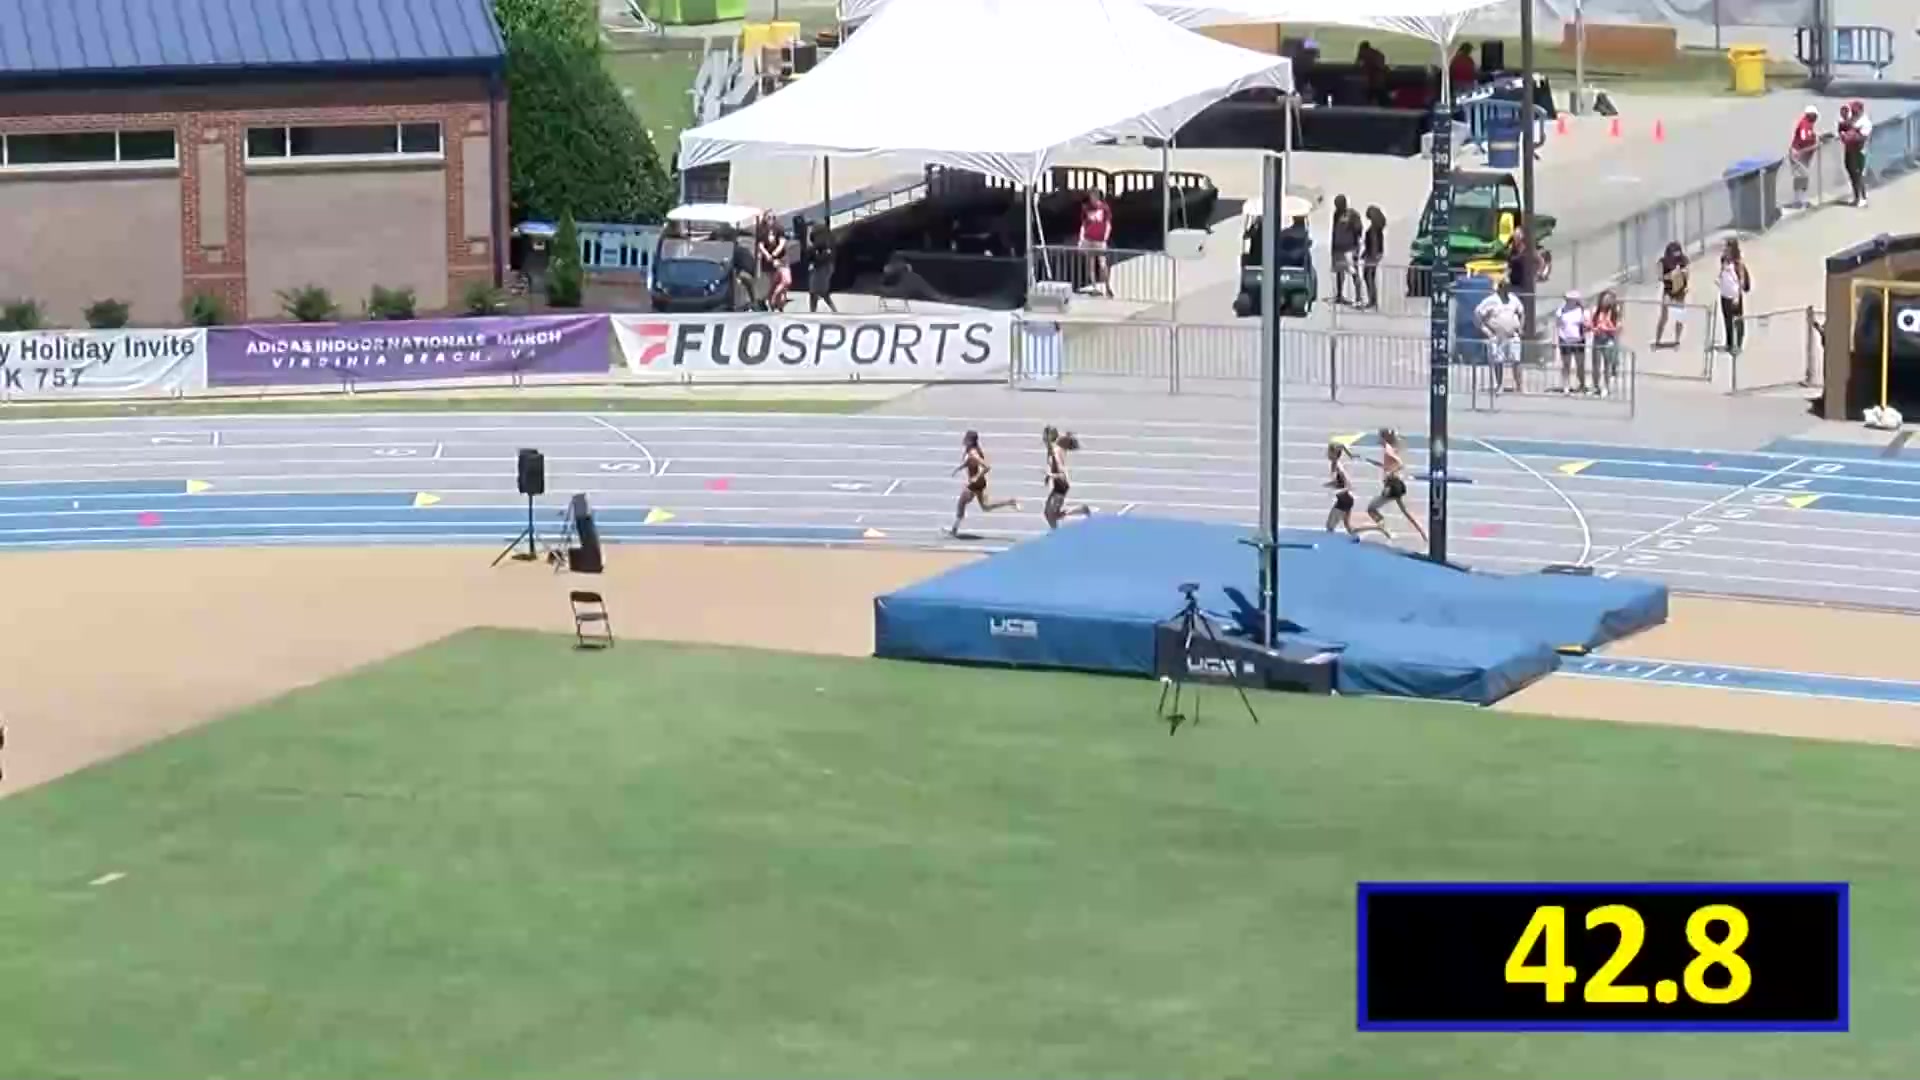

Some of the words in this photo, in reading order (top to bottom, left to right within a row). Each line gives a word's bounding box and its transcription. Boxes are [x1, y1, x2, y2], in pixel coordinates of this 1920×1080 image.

[20, 336, 115, 363] Holiday
[125, 334, 195, 359] Invite
[673, 322, 993, 366] FLOSPORTS
[1433, 338, 1447, 349] 12
[35, 367, 84, 388] 757
[1433, 384, 1446, 395] 10
